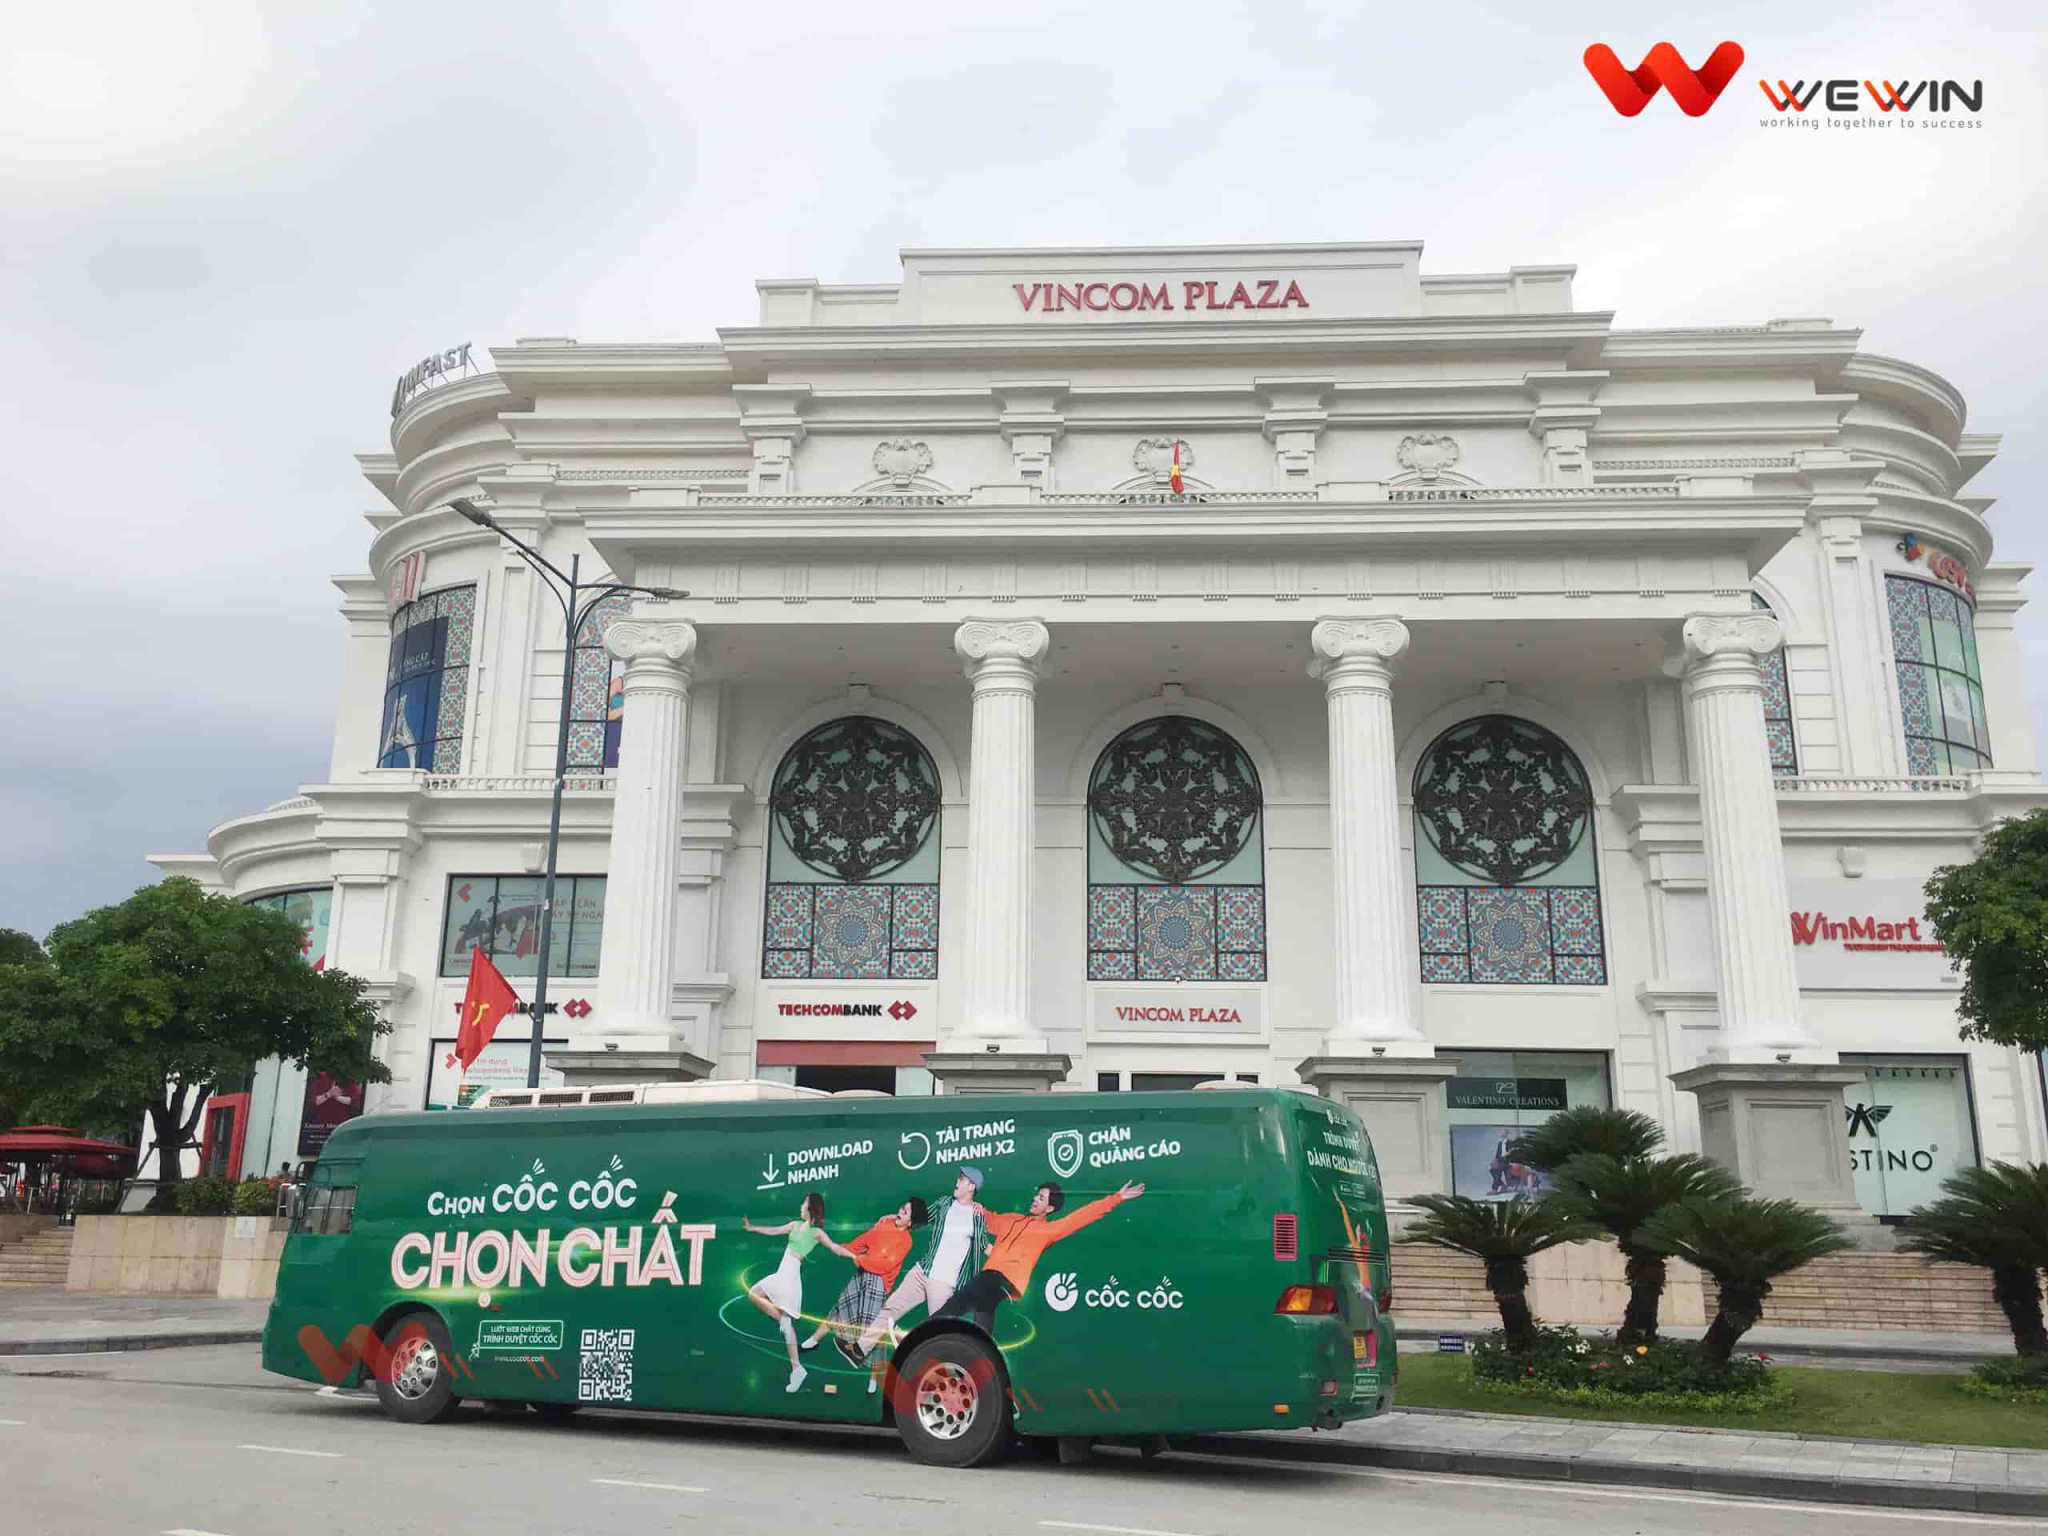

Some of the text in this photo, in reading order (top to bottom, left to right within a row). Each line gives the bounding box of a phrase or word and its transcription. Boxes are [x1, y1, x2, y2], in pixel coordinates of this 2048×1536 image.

[1012, 279, 1309, 312] VINCOM PLAZA
[1790, 912, 1922, 945] WinMart
[778, 1004, 882, 1016] TECHCOMBANK
[1116, 1006, 1242, 1023] VINCOM PLAZA
[1455, 1096, 1560, 1106] VALENTINO CREATIONS
[935, 1119, 1015, 1145] TẢI TRANG
[1088, 1126, 1131, 1145] CHẶN
[787, 1140, 874, 1166] DOWNLOAD
[935, 1139, 1015, 1165] NHANH X2
[1089, 1139, 1181, 1168] QUẢNG CÁO
[787, 1164, 839, 1185] NHANH
[391, 1190, 717, 1308] CHỌN CHẤT
